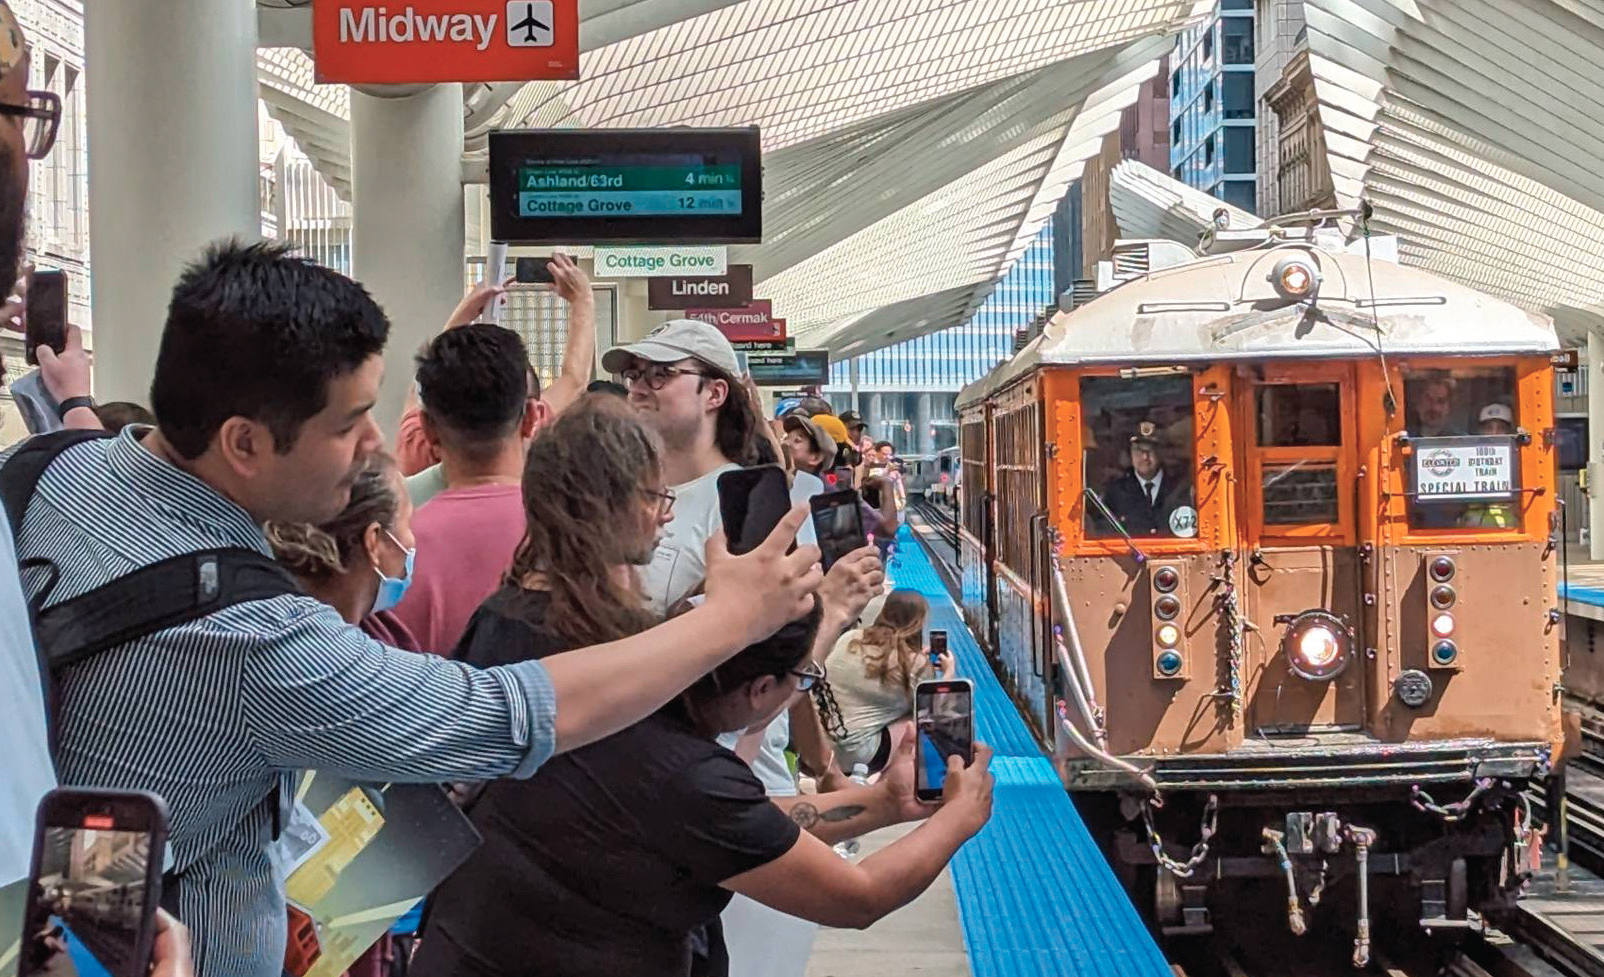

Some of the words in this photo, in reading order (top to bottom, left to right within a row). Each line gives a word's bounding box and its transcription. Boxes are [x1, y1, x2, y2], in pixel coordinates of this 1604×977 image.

[339, 7, 498, 50] Midway
[526, 174, 623, 188] Ashland/63rd
[685, 172, 695, 185] 4
[698, 172, 723, 185] min
[527, 200, 584, 214] Cottage
[588, 199, 632, 212] Grove
[678, 197, 695, 209] 12
[606, 254, 665, 270] Cottage
[670, 253, 715, 267] Grove
[672, 280, 729, 295] Linden
[1420, 481, 1467, 493] SPECIAL
[1474, 480, 1509, 492] TRAIN
